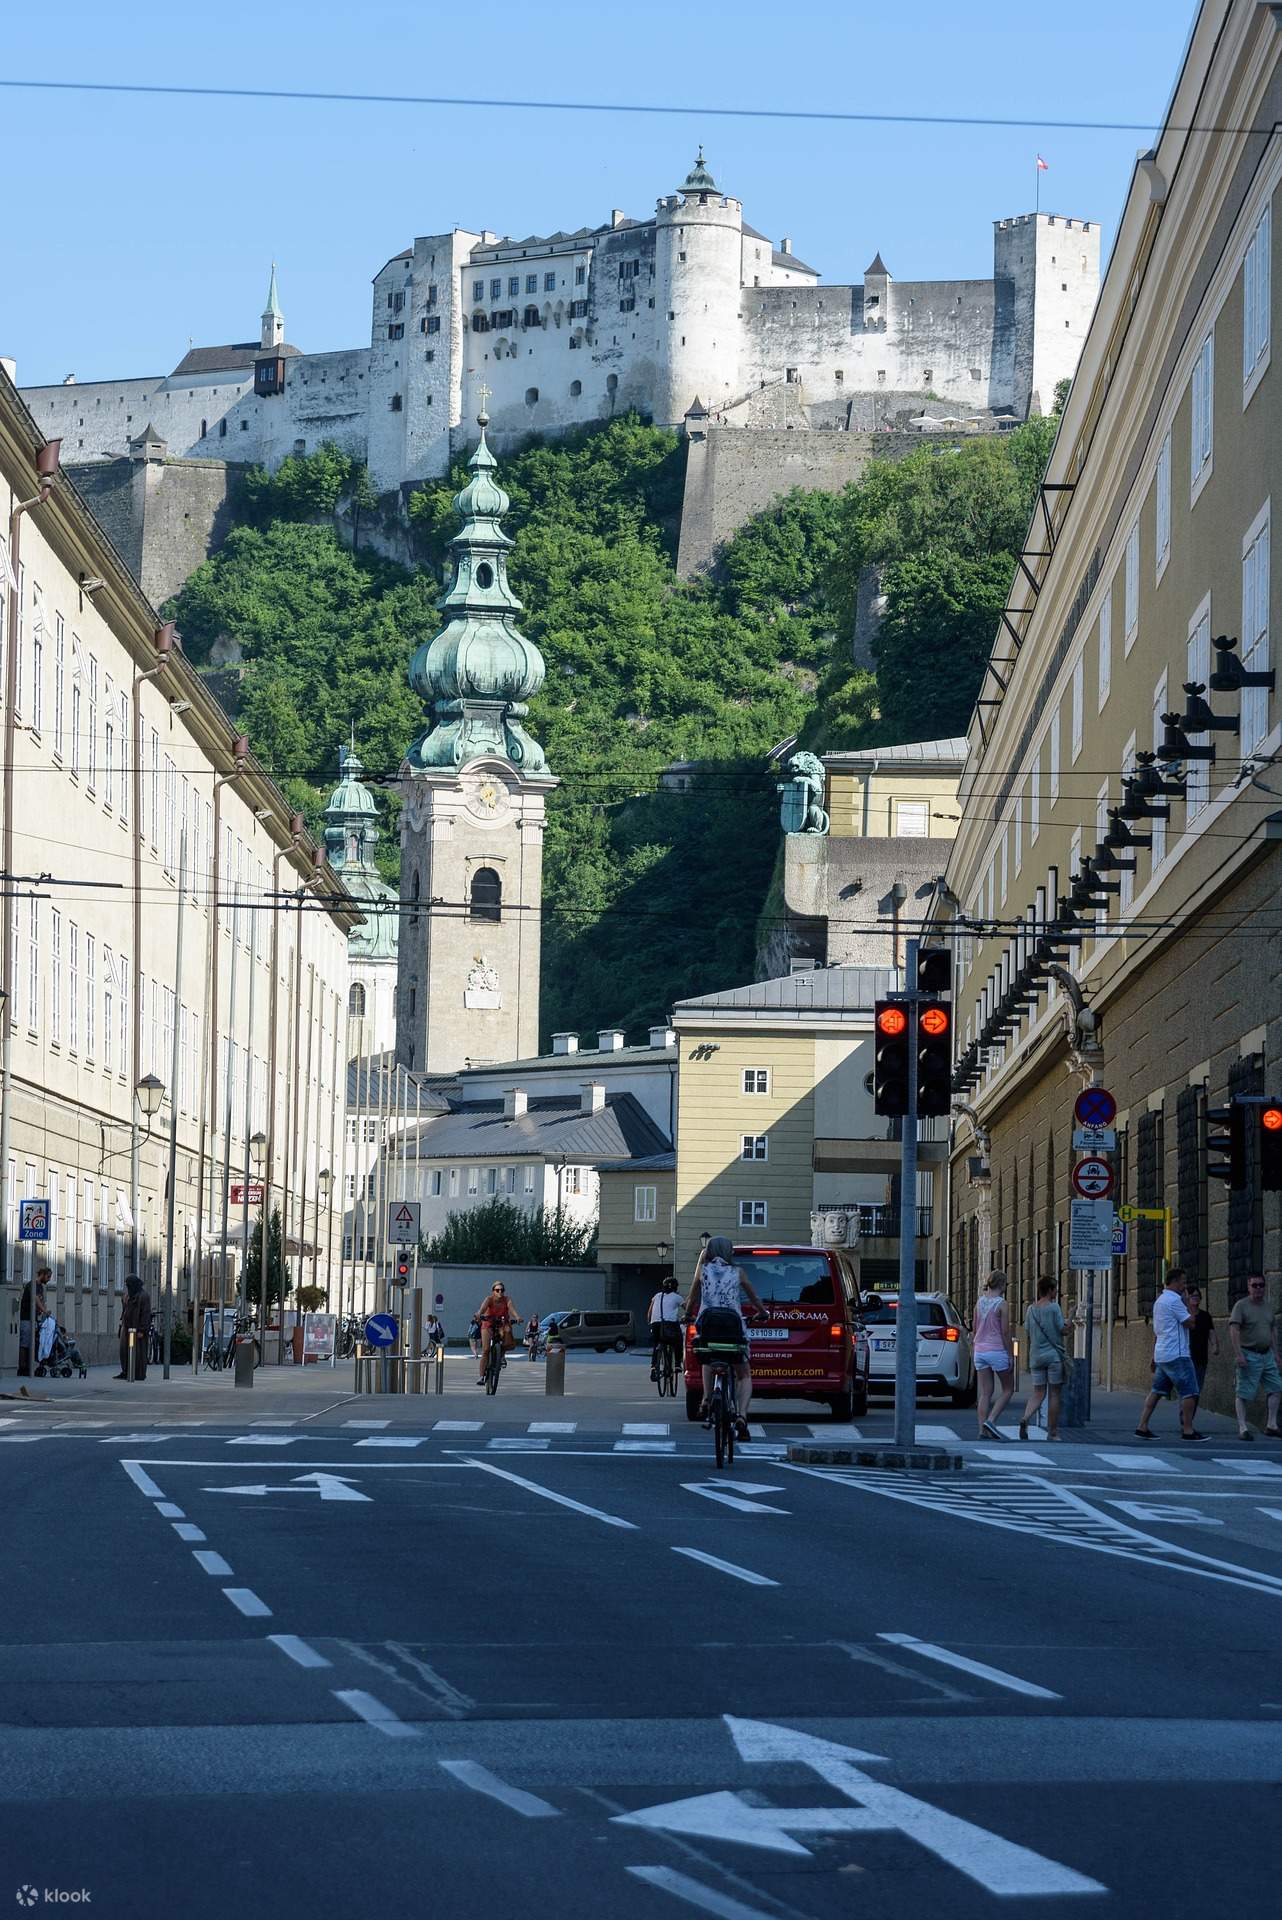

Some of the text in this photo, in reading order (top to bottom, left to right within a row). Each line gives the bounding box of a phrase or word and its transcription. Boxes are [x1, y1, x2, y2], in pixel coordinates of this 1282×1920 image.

[1082, 1121, 1107, 1129] ANFANG
[1122, 1207, 1132, 1219] H
[35, 1219, 44, 1228] 20
[24, 1230, 44, 1238] Zone
[1112, 1233, 1122, 1242] 20
[773, 1311, 829, 1320] PANORAMA
